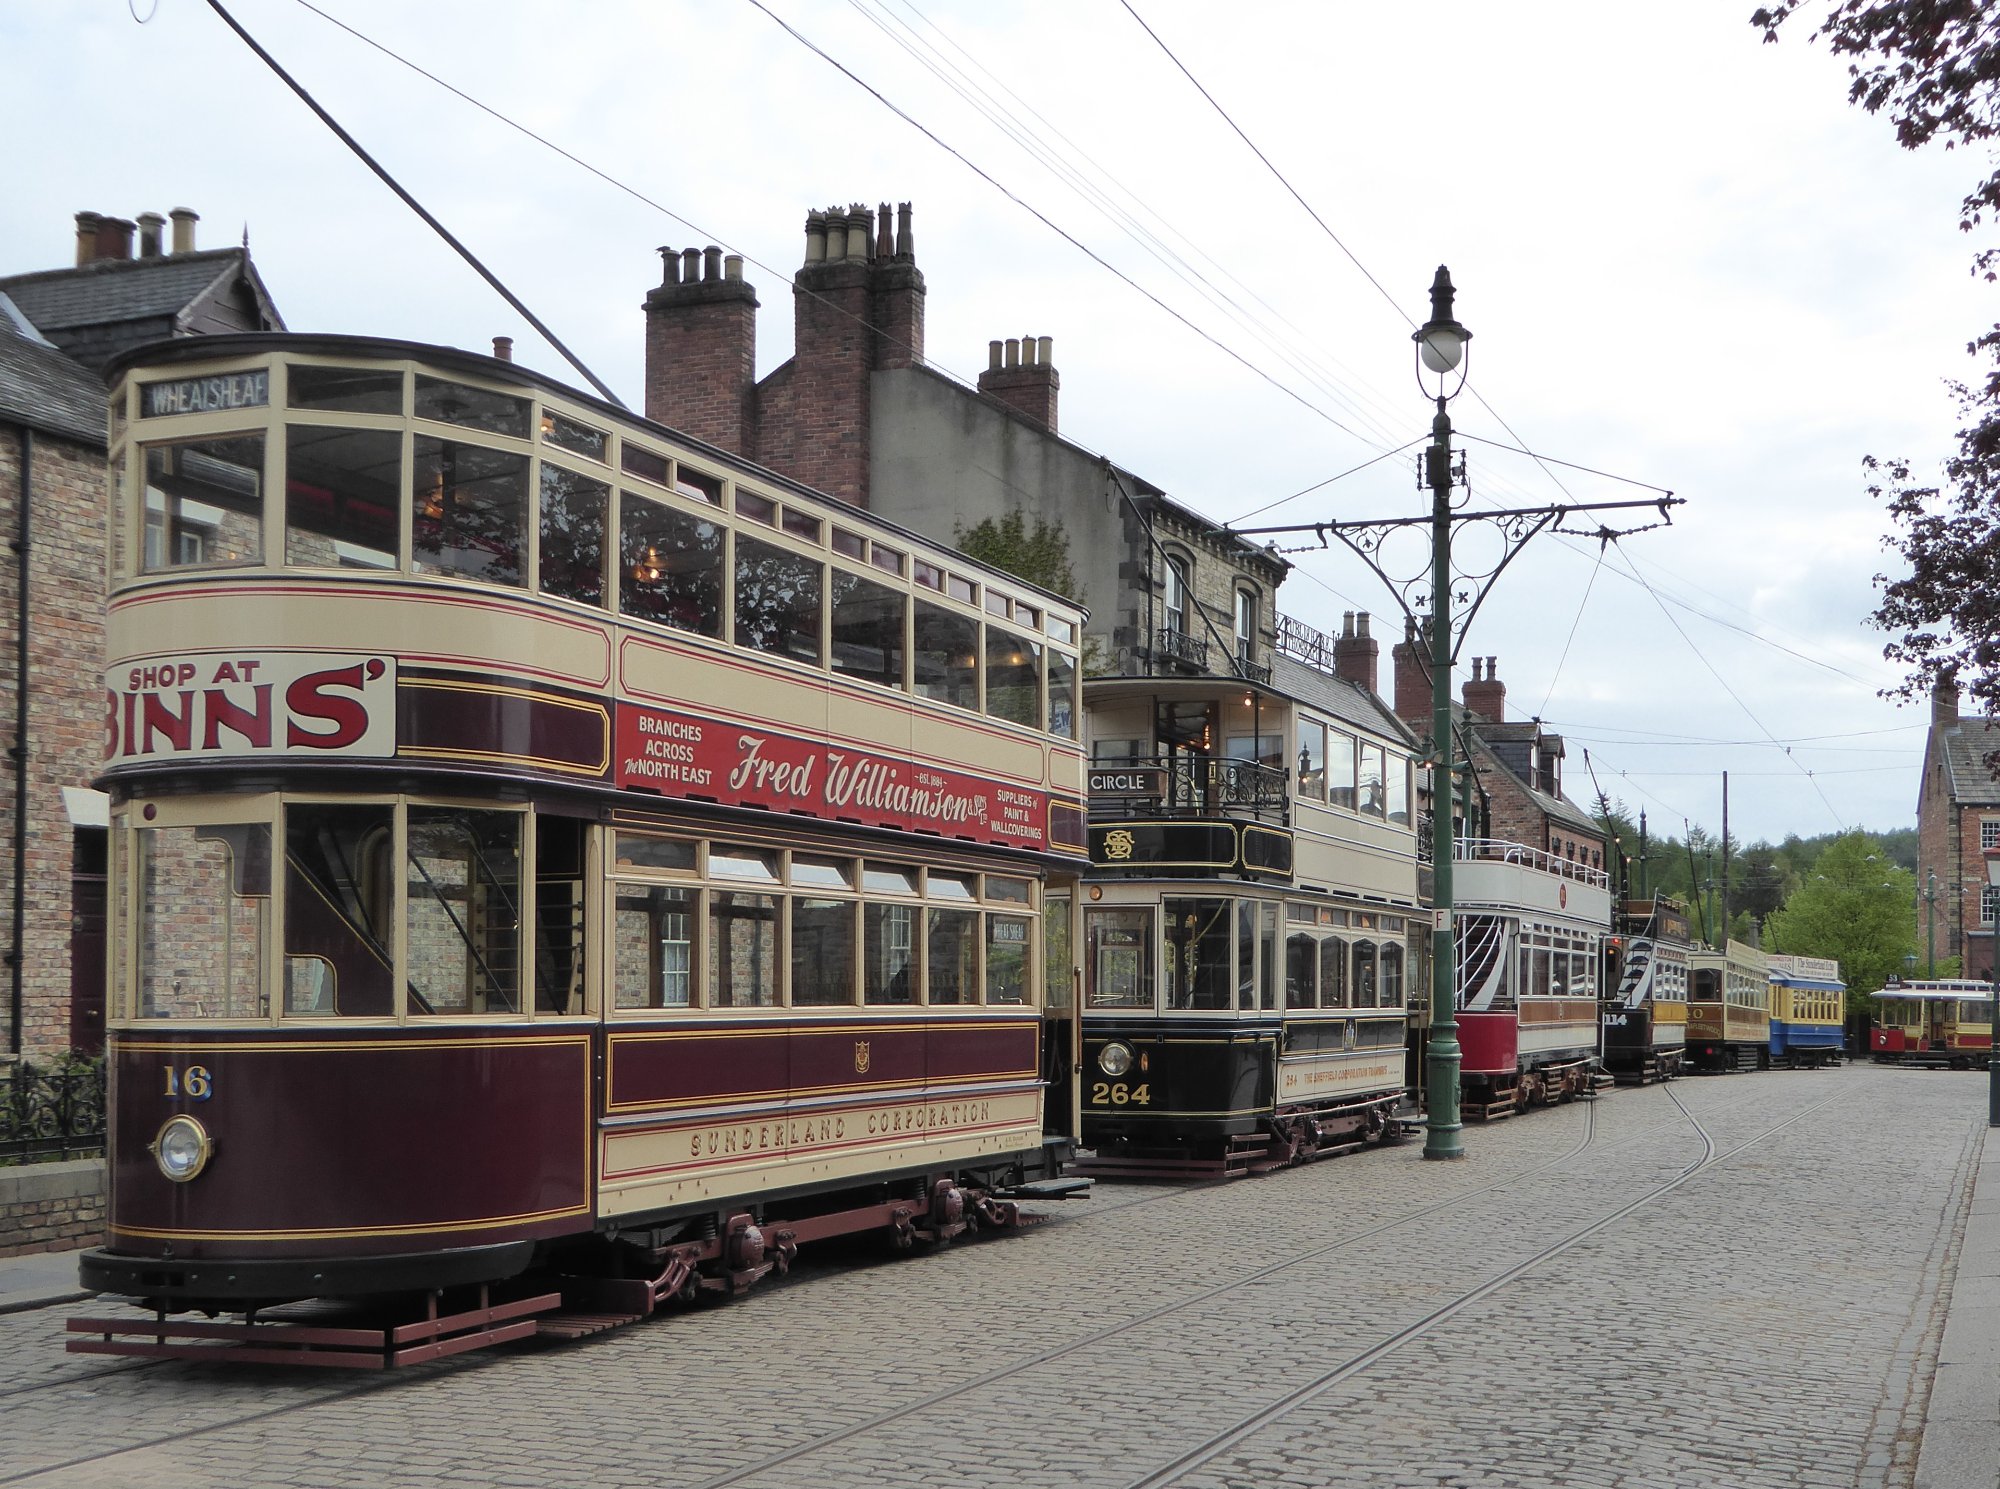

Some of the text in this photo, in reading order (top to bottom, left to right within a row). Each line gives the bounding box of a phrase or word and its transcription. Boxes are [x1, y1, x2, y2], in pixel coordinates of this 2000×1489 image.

[152, 376, 265, 414] WHEATSHEAF
[128, 660, 261, 691] SHOP AT
[639, 715, 702, 742] BRANCHES
[645, 739, 694, 763] ACROSS
[638, 759, 678, 781] NORTH
[682, 767, 712, 786] EAST
[730, 735, 816, 797] Fred
[825, 752, 968, 823] Williamson
[1091, 775, 1145, 790] CIRCLE
[997, 789, 1032, 808] SUPPLIERS
[1004, 806, 1029, 823] PAINT &
[990, 820, 1042, 840] WALLCOVERINGS
[1436, 911, 1444, 928] F
[1605, 1014, 1627, 1026] 114
[164, 1065, 212, 1100] 16
[1091, 1083, 1150, 1106] 264
[691, 1101, 991, 1157] SUNDERLAND CORPORATION
